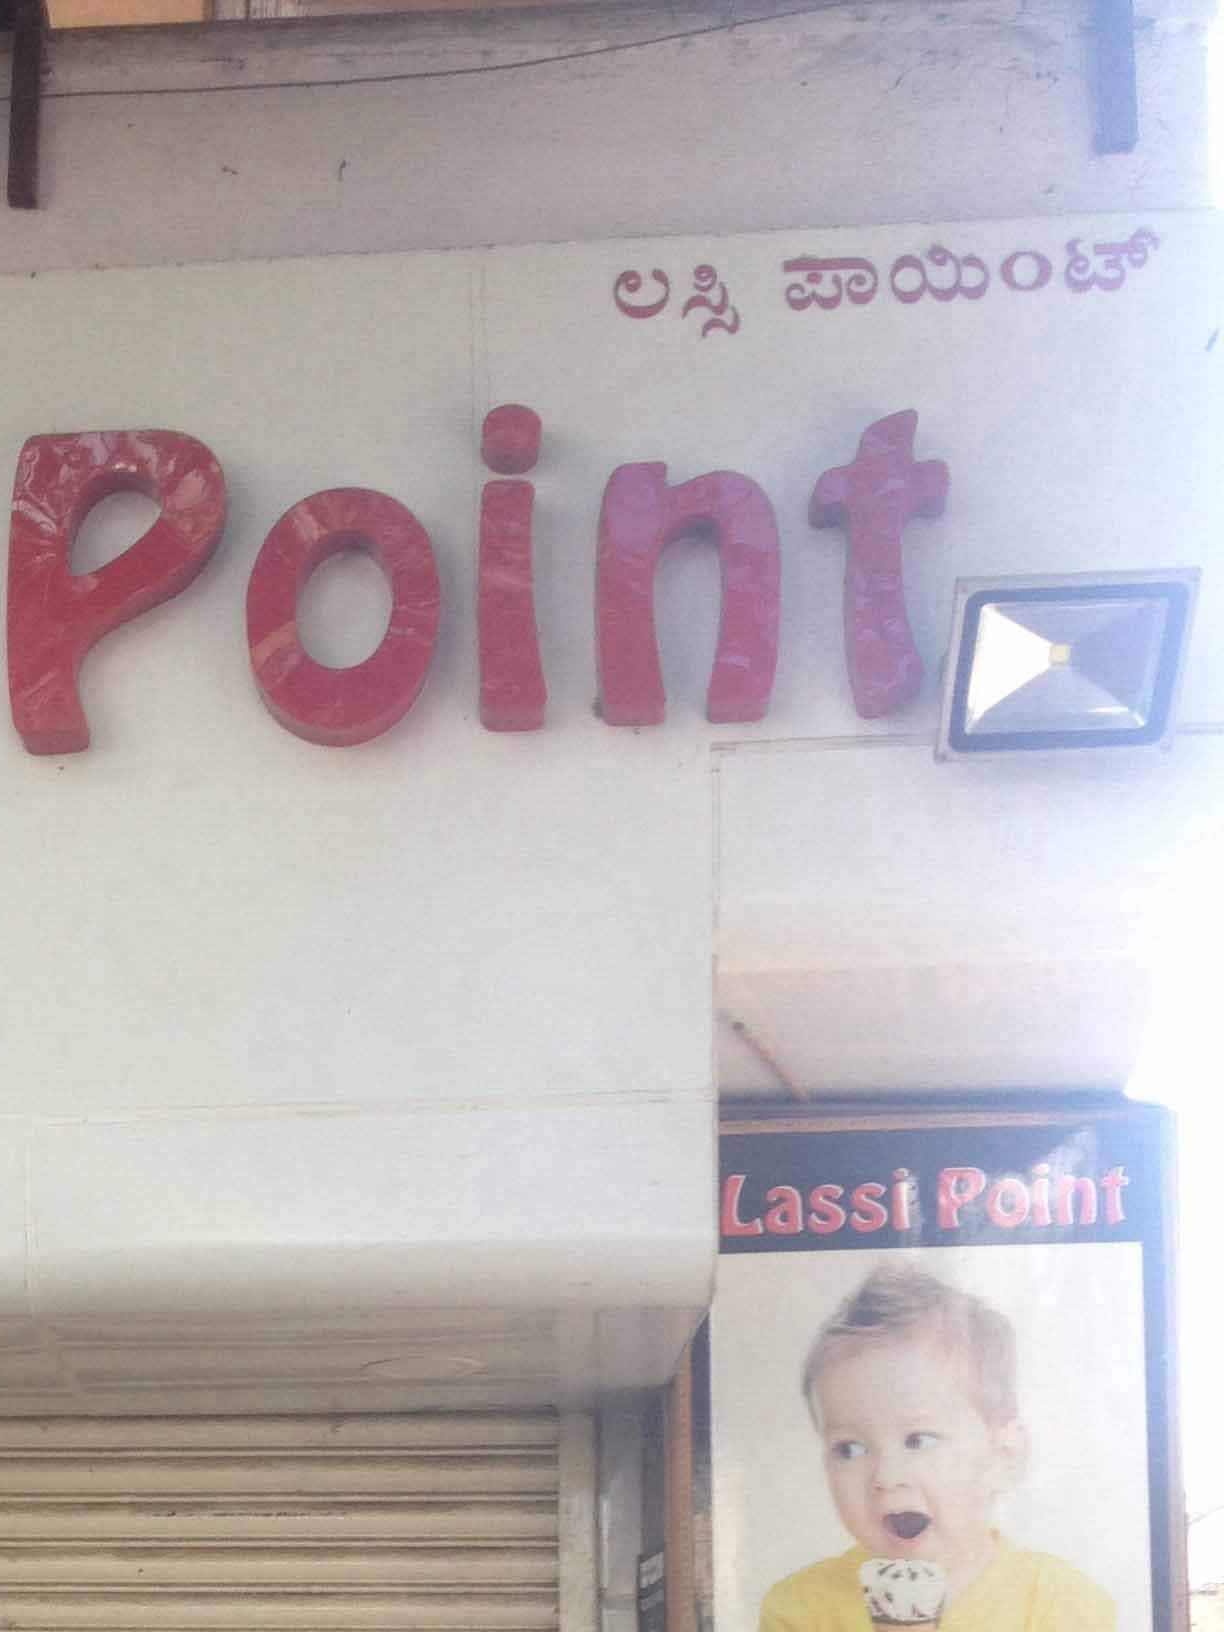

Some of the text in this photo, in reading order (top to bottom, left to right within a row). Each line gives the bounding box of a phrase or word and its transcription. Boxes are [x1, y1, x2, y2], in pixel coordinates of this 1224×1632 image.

[614, 227, 1160, 338] ಲಸ್ಸಿ ಪಾಯಿಂಟ್
[6, 402, 950, 756] Point
[720, 1163, 1129, 1237] Lassi Point
